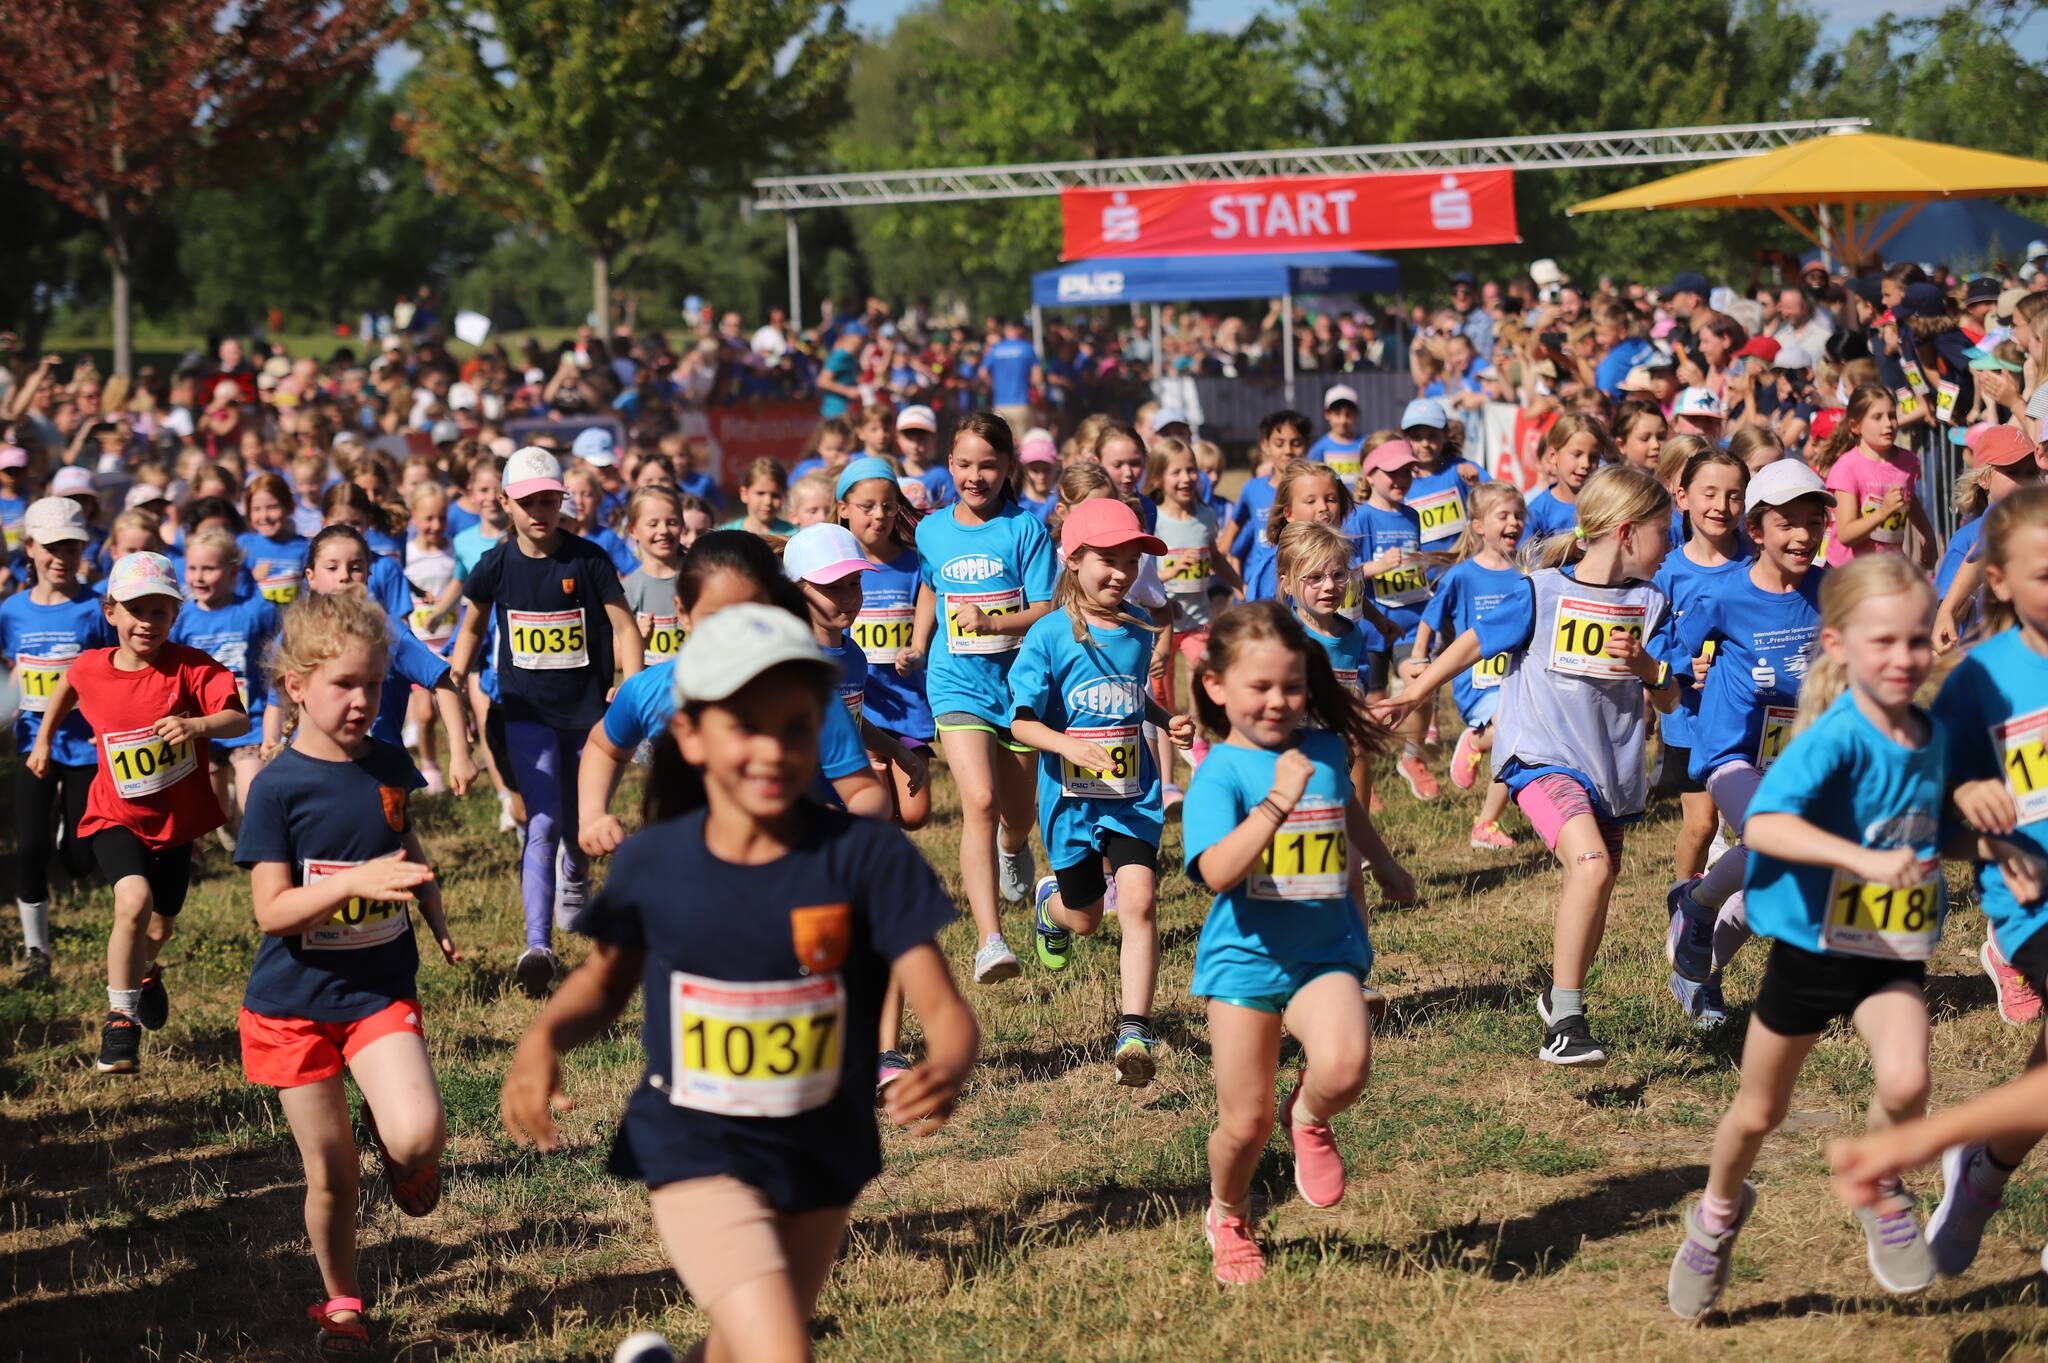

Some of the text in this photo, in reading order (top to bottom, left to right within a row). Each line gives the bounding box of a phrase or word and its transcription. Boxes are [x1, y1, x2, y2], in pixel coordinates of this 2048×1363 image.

[1209, 189, 1358, 239] START
[1421, 501, 1460, 529] 071
[514, 625, 584, 653] 1035
[856, 621, 915, 648] 1012
[1560, 619, 1643, 659] 10
[1073, 744, 1137, 779] 81
[322, 893, 403, 926] 04
[688, 1014, 837, 1076] 1037
